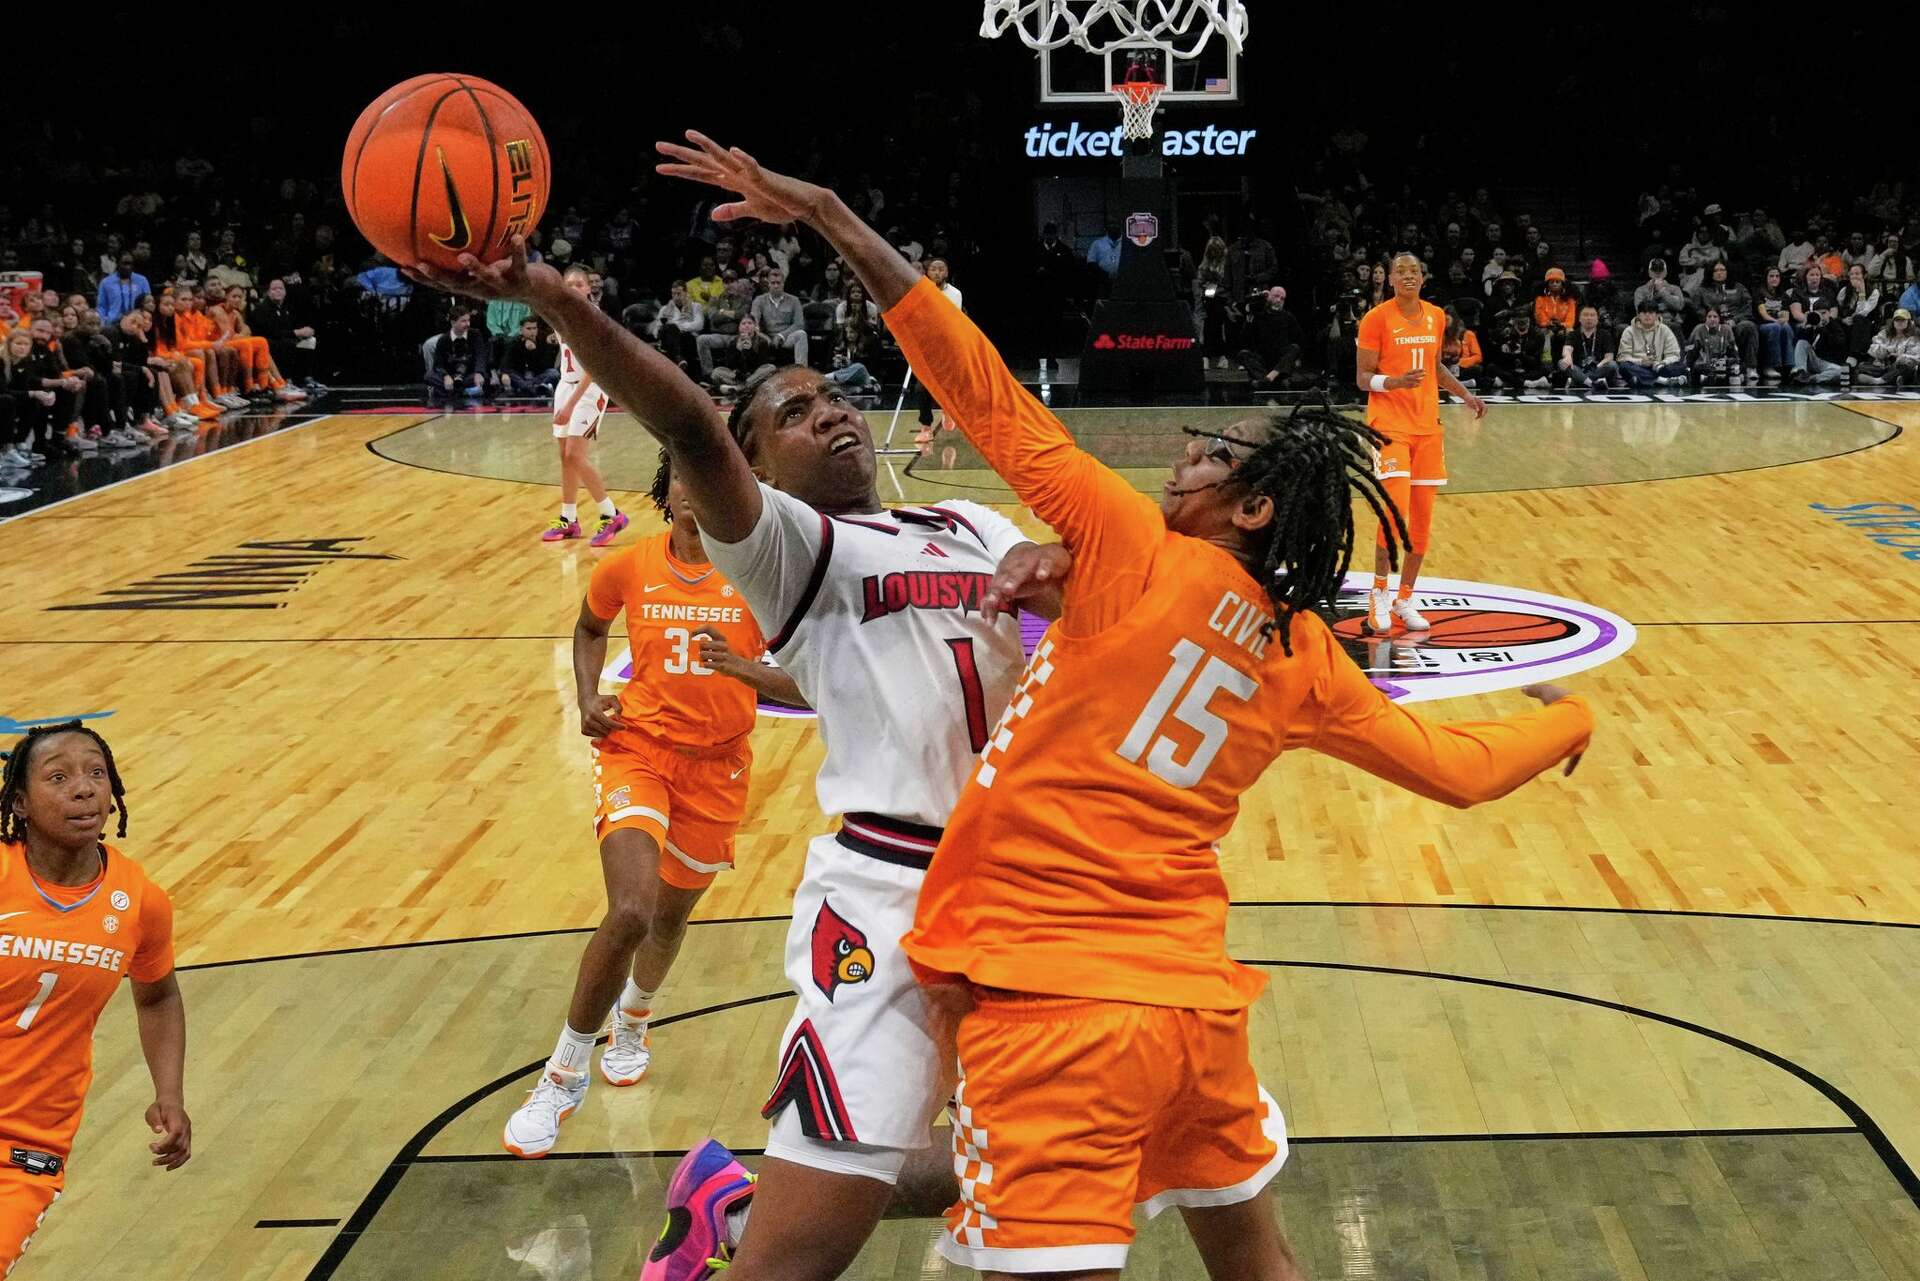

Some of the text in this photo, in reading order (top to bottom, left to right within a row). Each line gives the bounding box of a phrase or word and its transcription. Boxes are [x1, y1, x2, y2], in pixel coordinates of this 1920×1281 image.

[1024, 122, 1257, 157] ticketaster
[497, 138, 536, 249] ELITE
[1411, 348, 1425, 371] 11
[1440, 391, 1920, 405] ROOKLYN
[39, 535, 409, 612] NINJA
[860, 570, 1019, 624] LOUISVI
[641, 603, 743, 624] TENNESSEE
[943, 637, 990, 754] 1
[1115, 637, 1260, 788] 15
[0, 933, 125, 973] ENNESSEE
[15, 971, 59, 1031] 1
